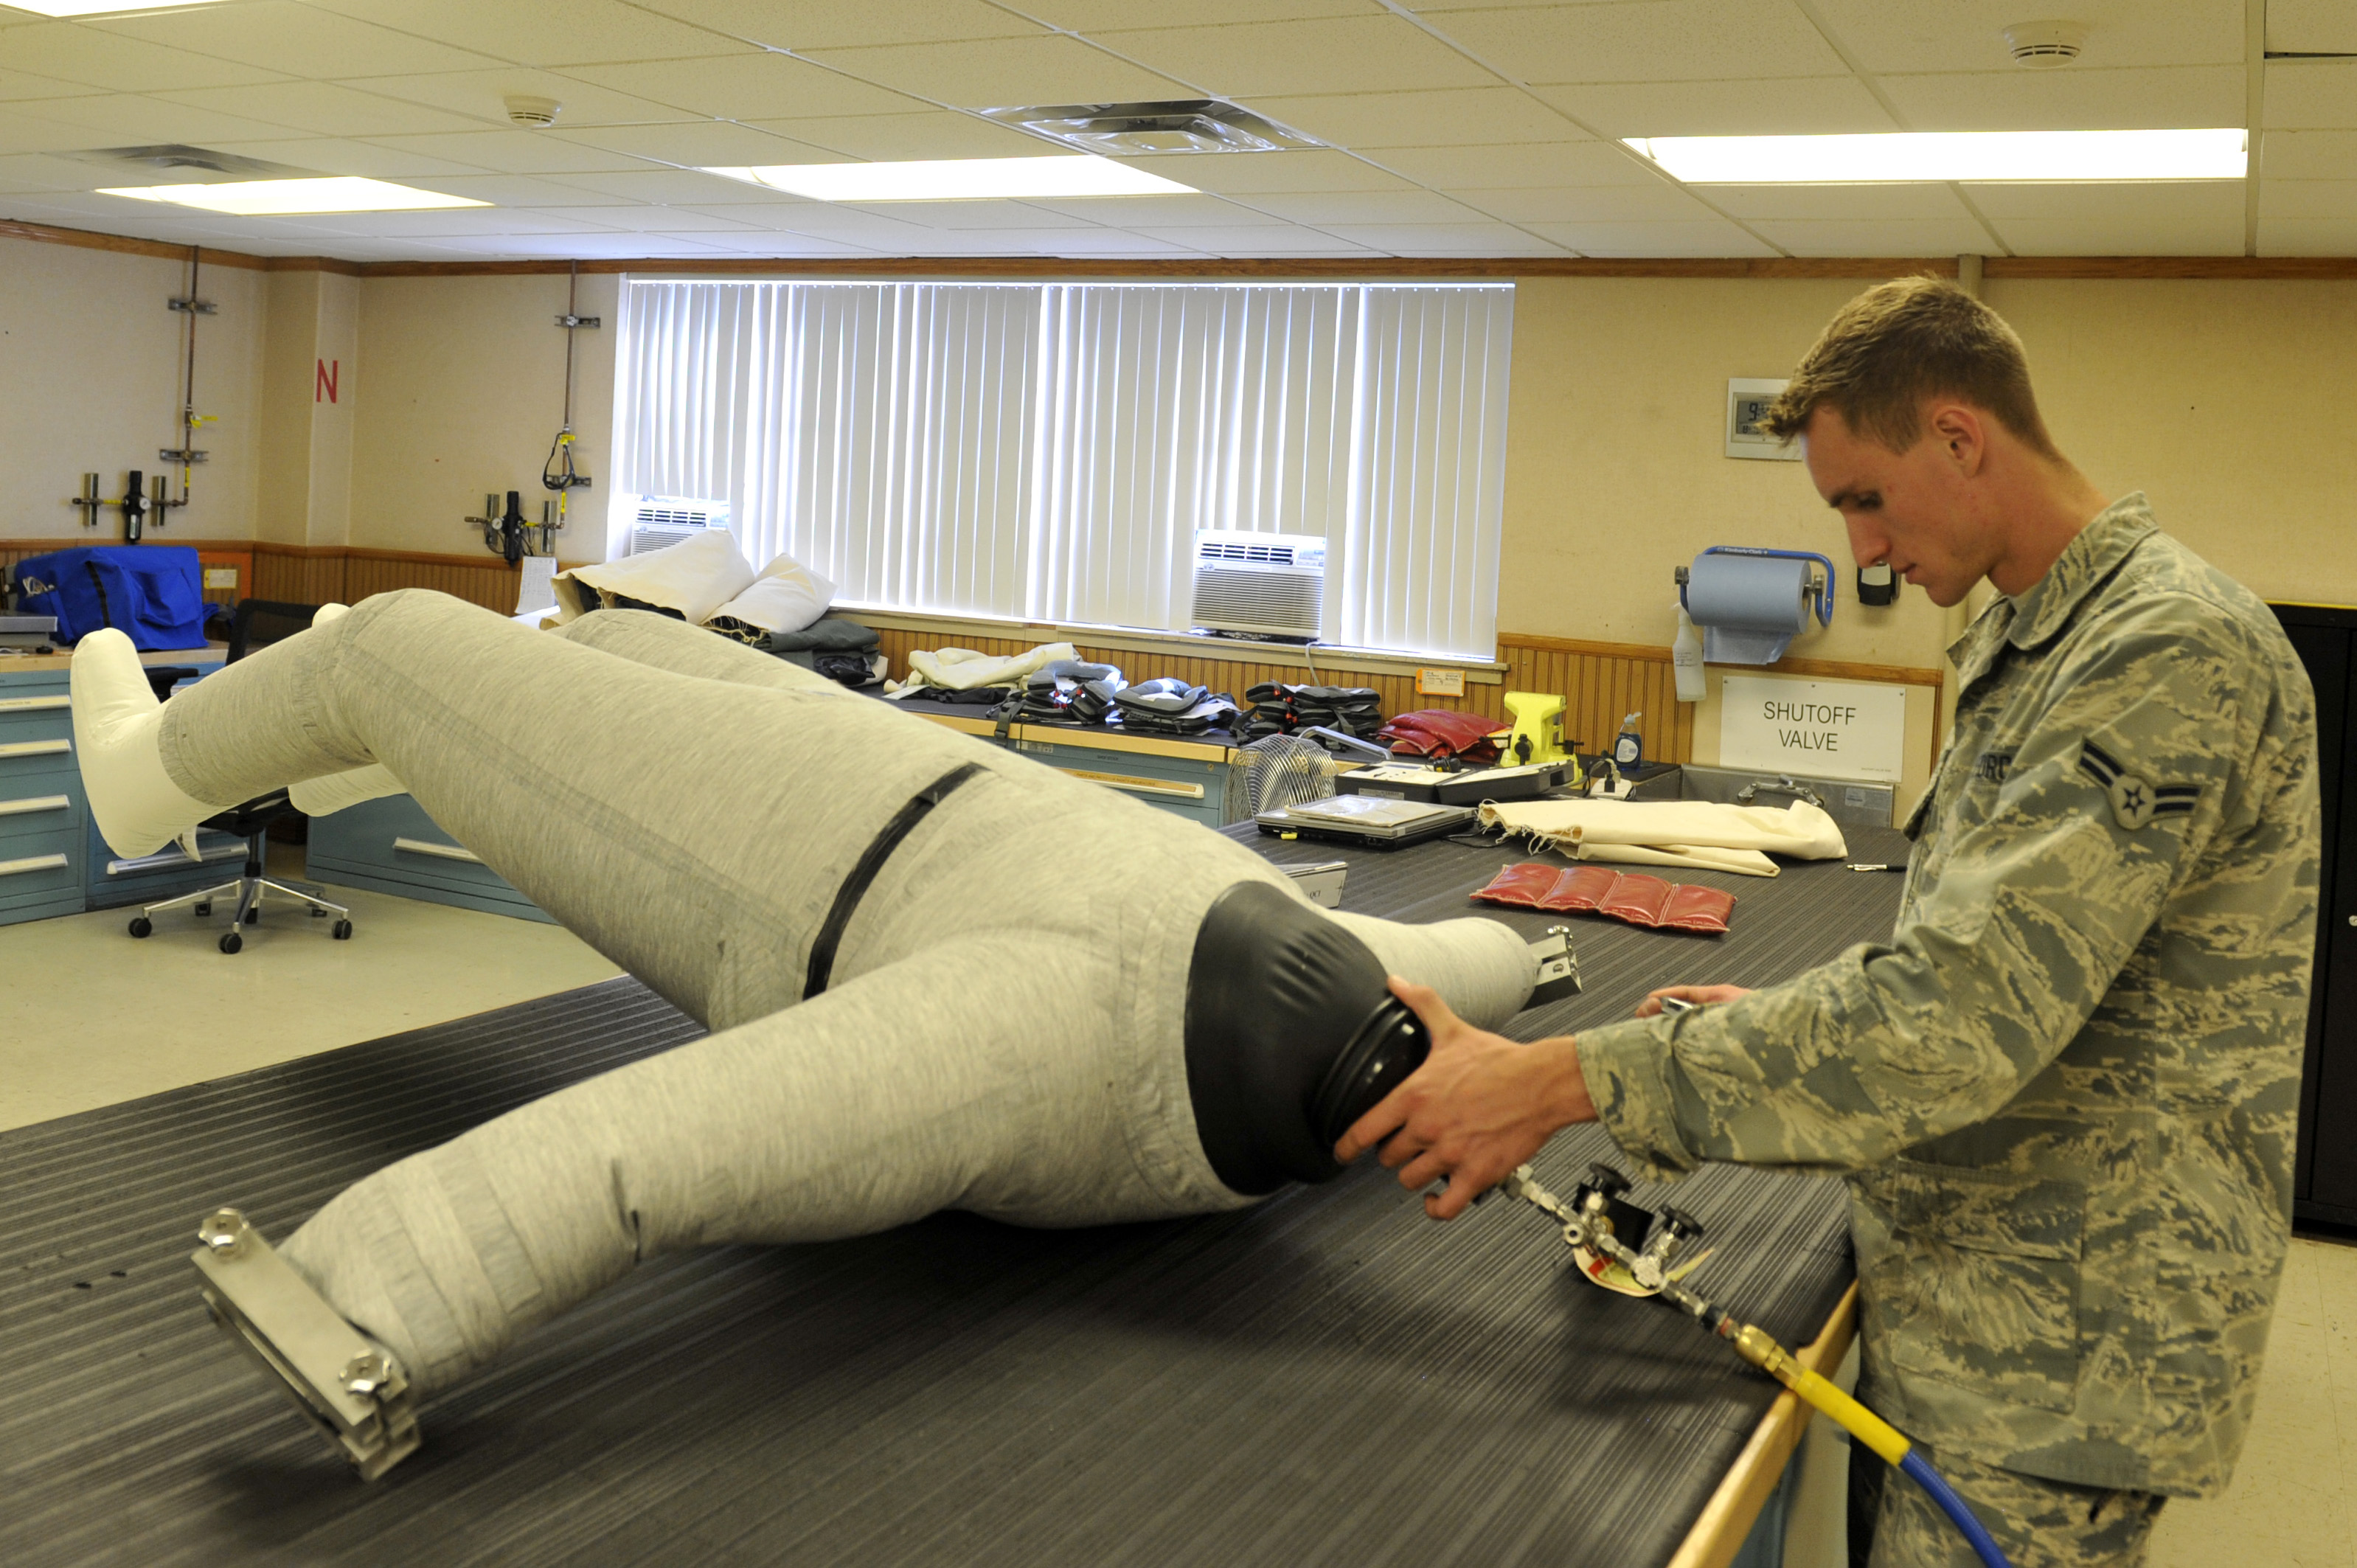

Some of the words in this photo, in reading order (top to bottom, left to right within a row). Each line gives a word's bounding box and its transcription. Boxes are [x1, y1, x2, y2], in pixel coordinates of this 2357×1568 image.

[316, 358, 339, 404] N
[1763, 701, 1857, 726] SHUTOFF
[1779, 729, 1839, 752] VALVE
[1976, 753, 2013, 780] ORC
